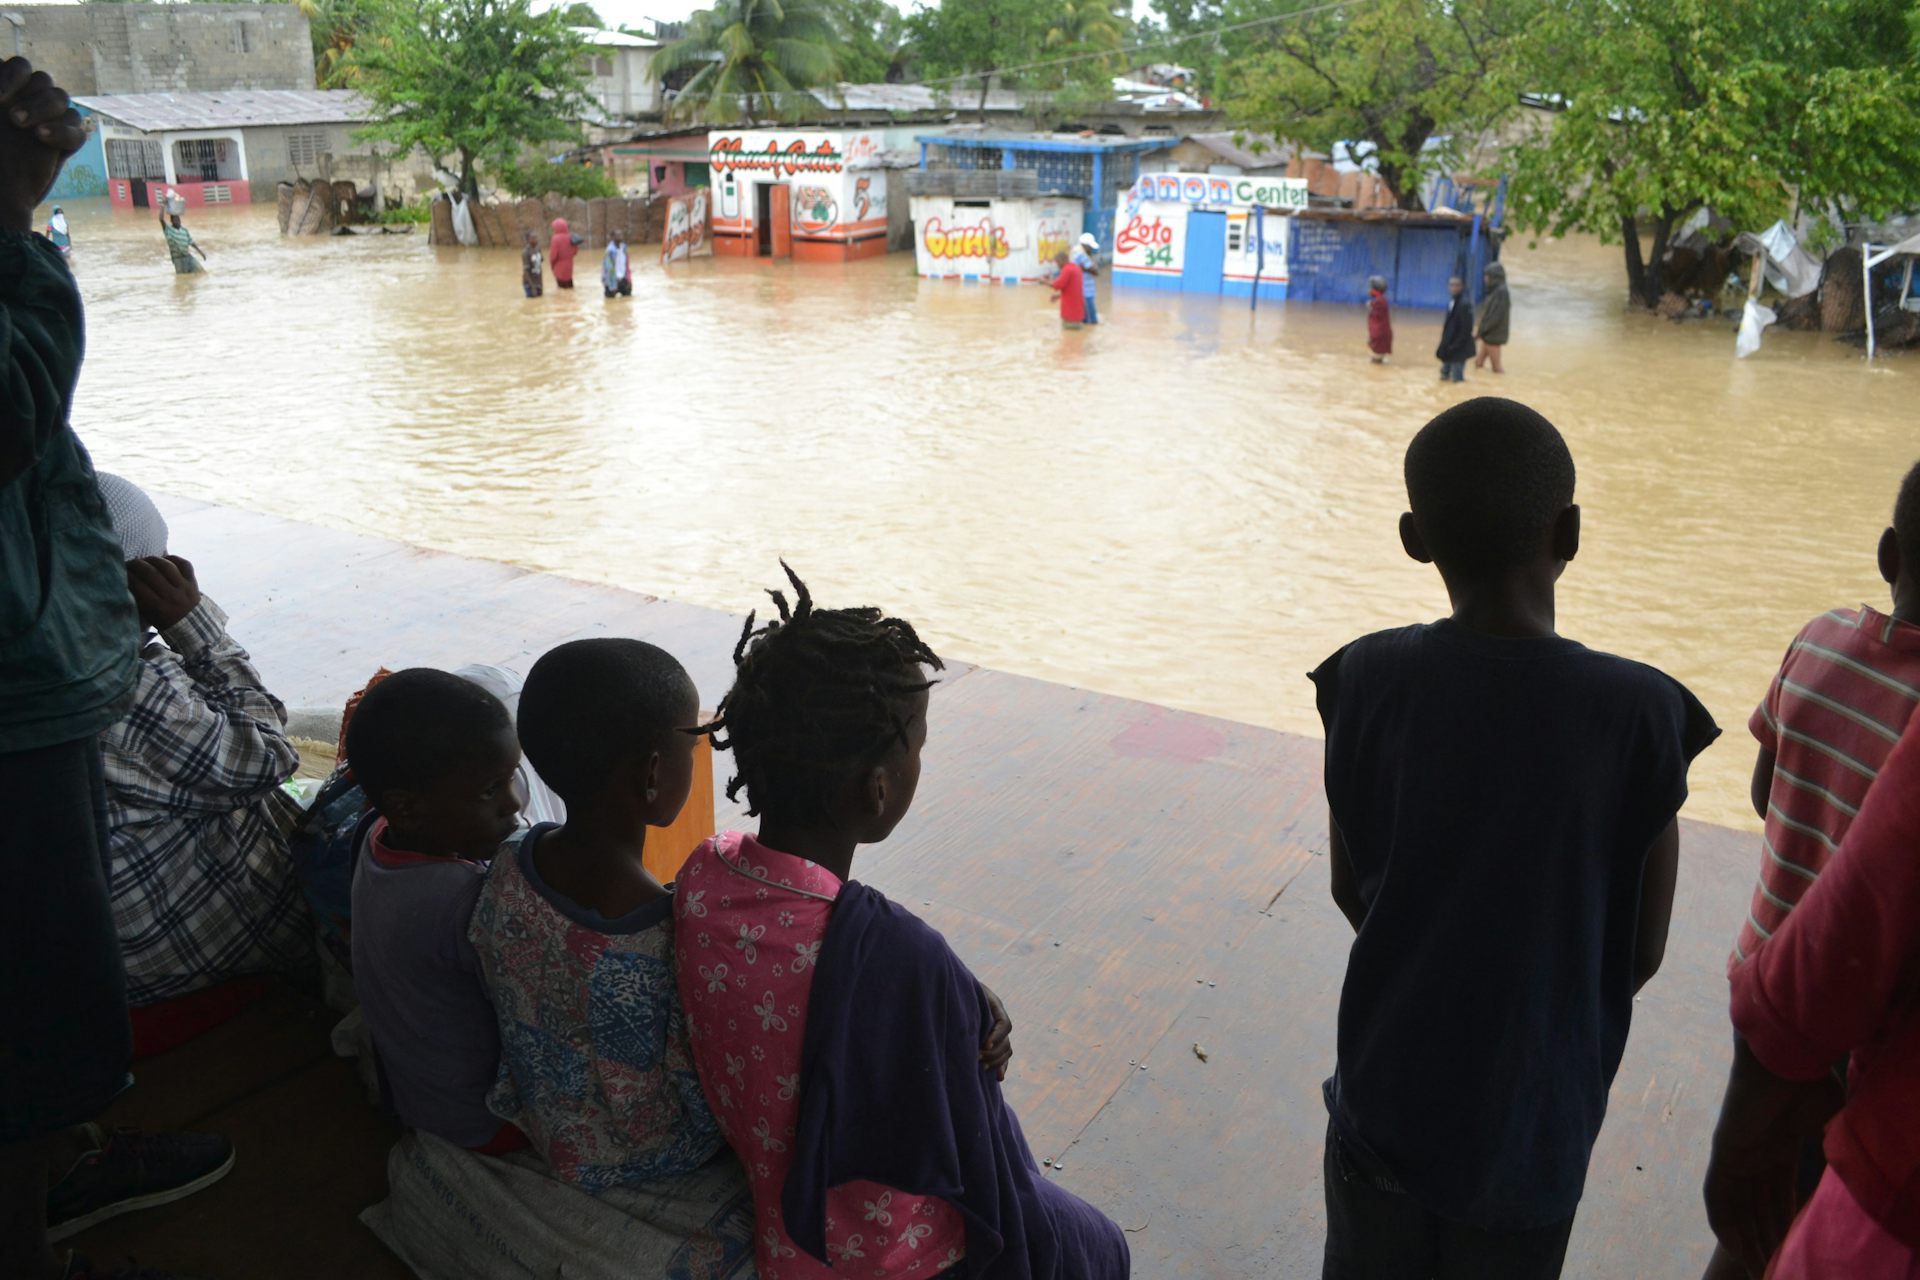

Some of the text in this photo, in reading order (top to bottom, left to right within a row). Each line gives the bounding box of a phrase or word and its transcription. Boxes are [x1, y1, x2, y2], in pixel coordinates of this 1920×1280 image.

[1236, 181, 1308, 205] Center
[1116, 214, 1172, 253] Loto
[1144, 244, 1173, 266] 34
